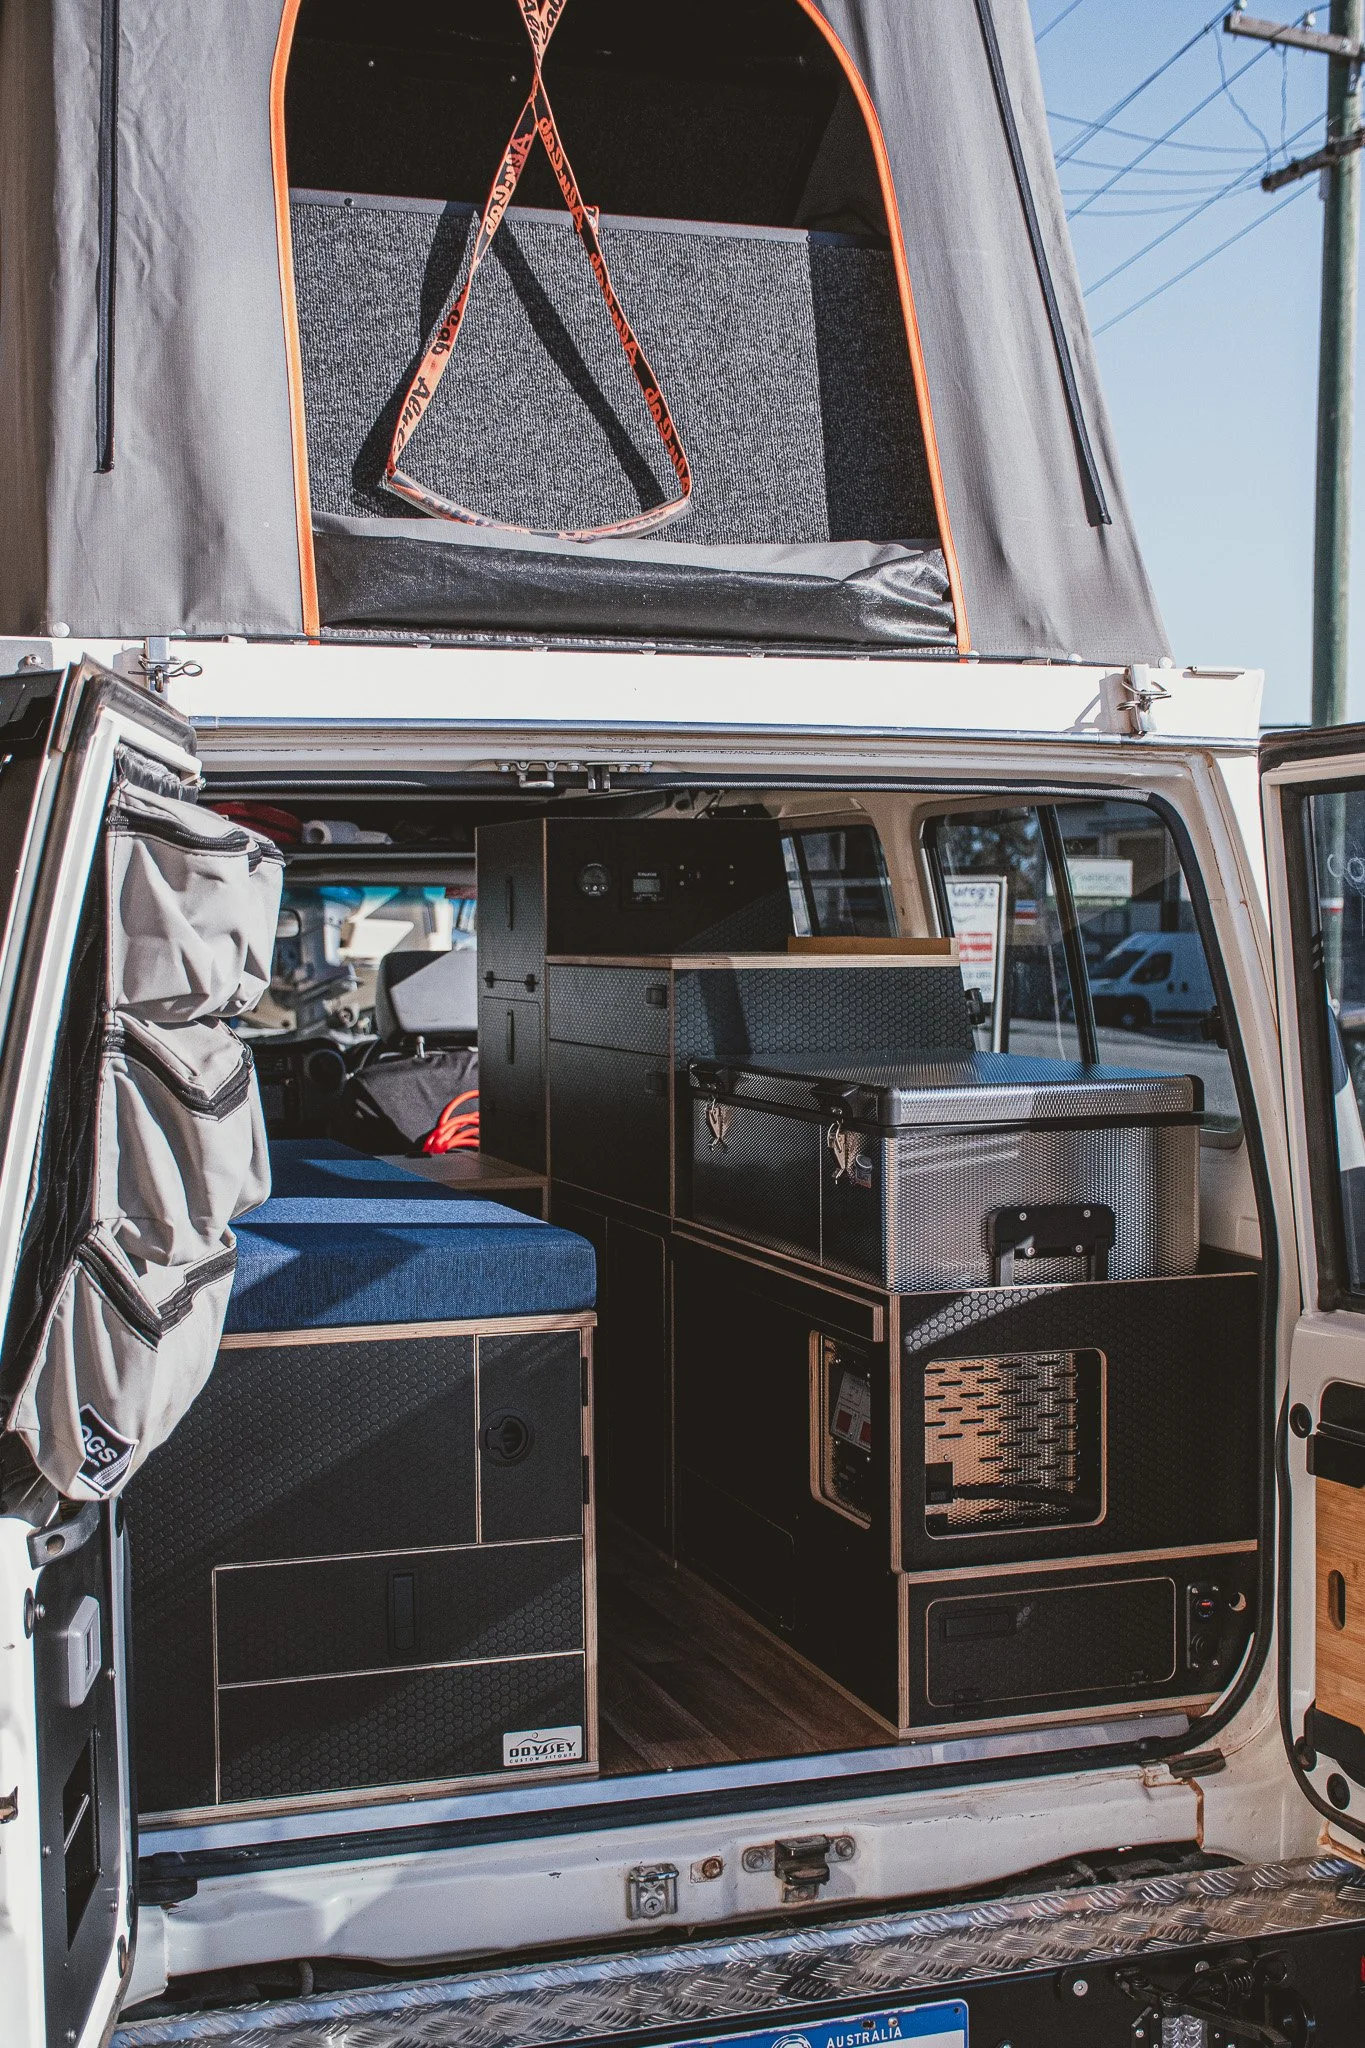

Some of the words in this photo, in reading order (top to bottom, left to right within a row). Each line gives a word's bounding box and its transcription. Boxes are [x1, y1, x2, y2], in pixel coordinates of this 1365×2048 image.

[509, 1742, 576, 1758] ODYSSEY
[509, 1756, 540, 1764] CUSTOM
[827, 2026, 902, 2048] AUSTRALIA
